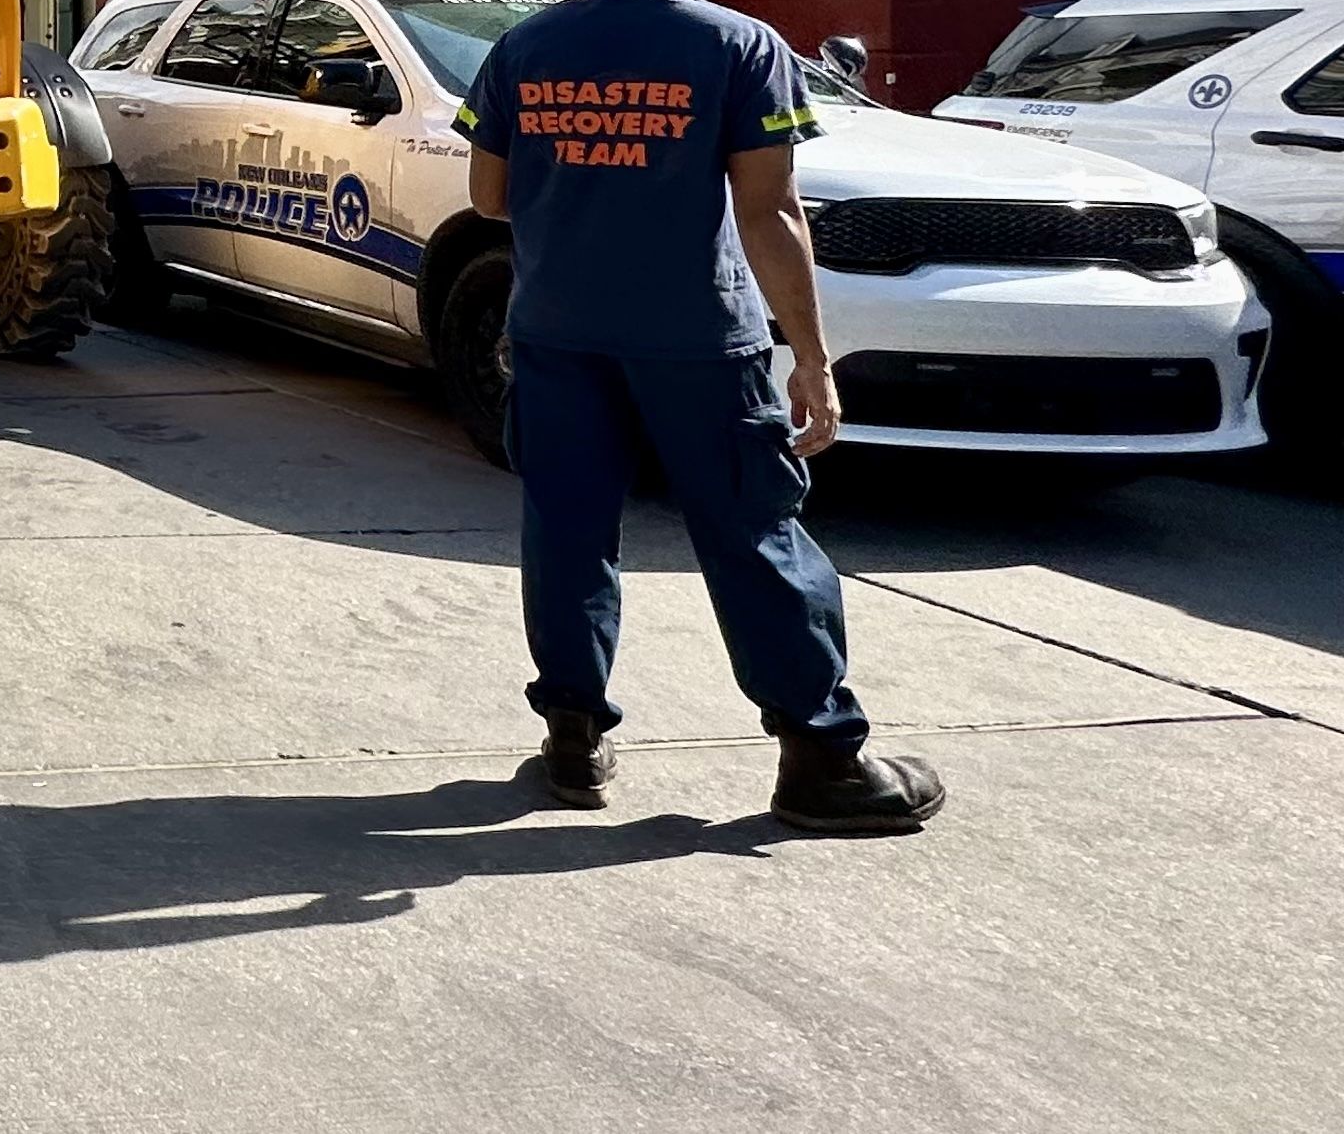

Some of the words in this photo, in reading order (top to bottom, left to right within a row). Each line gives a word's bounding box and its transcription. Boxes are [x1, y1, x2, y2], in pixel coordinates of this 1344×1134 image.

[519, 81, 693, 108] DISASTER
[1019, 103, 1077, 116] 23239
[518, 110, 696, 138] RECOVERY
[554, 140, 648, 167] TEAM
[238, 164, 266, 183] NEW
[192, 177, 329, 242] POLICE
